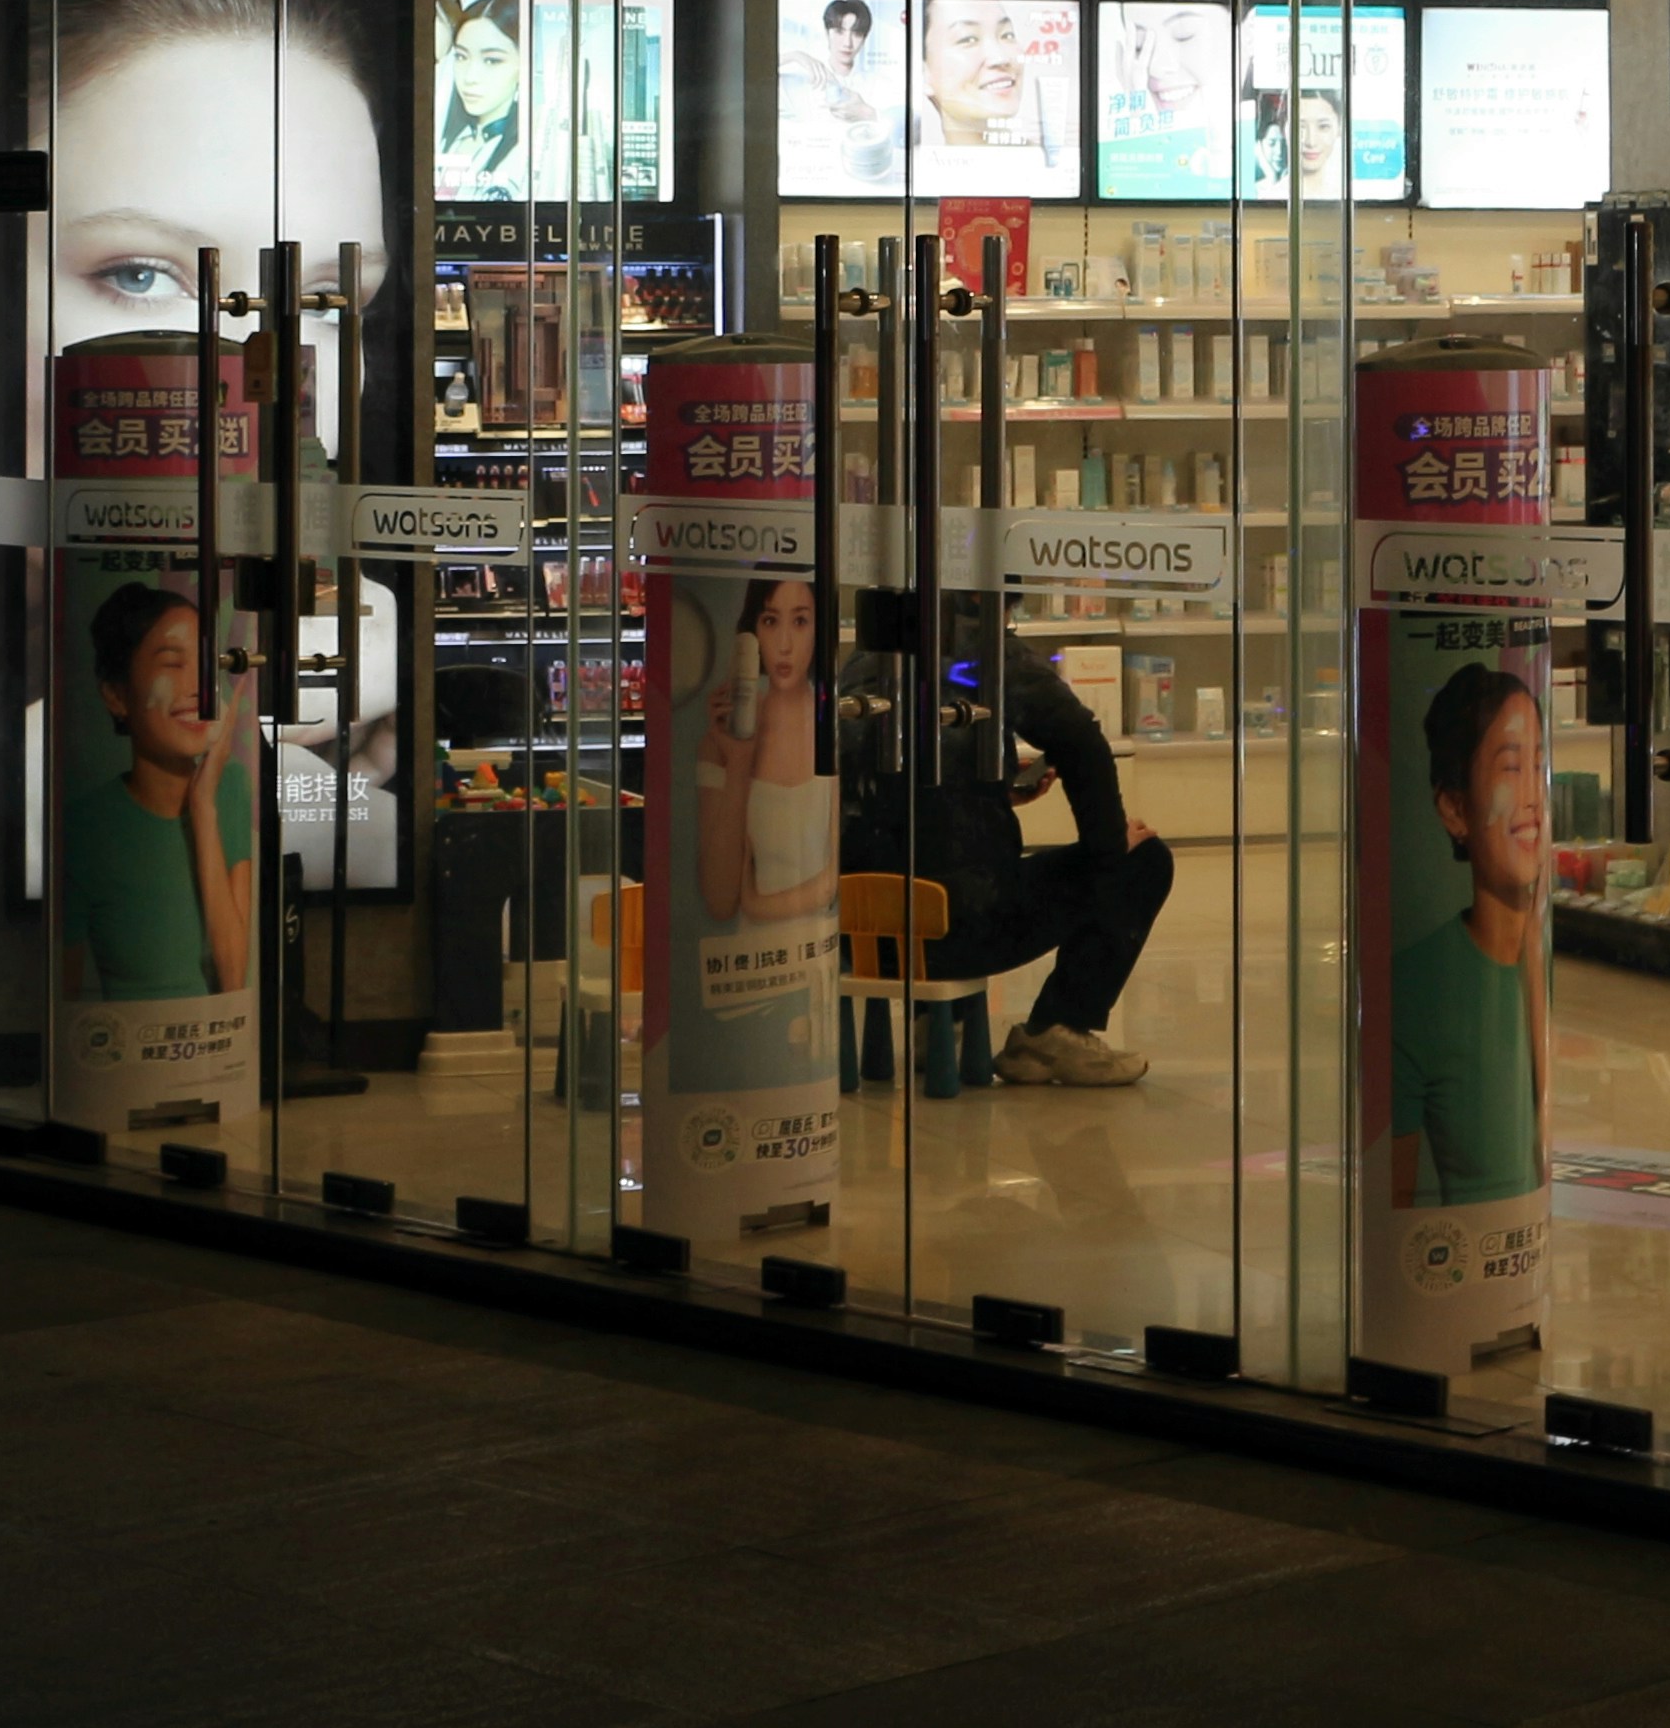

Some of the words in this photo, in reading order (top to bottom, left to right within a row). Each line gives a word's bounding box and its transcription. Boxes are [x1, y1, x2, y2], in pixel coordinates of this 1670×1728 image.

[1299, 42, 1357, 77] Curl
[83, 501, 194, 530] watsons
[373, 508, 498, 539] watsons
[655, 519, 798, 554] watsons
[1028, 535, 1193, 572] watsons
[1406, 621, 1505, 651] 一起变美
[319, 807, 369, 822] FISH
